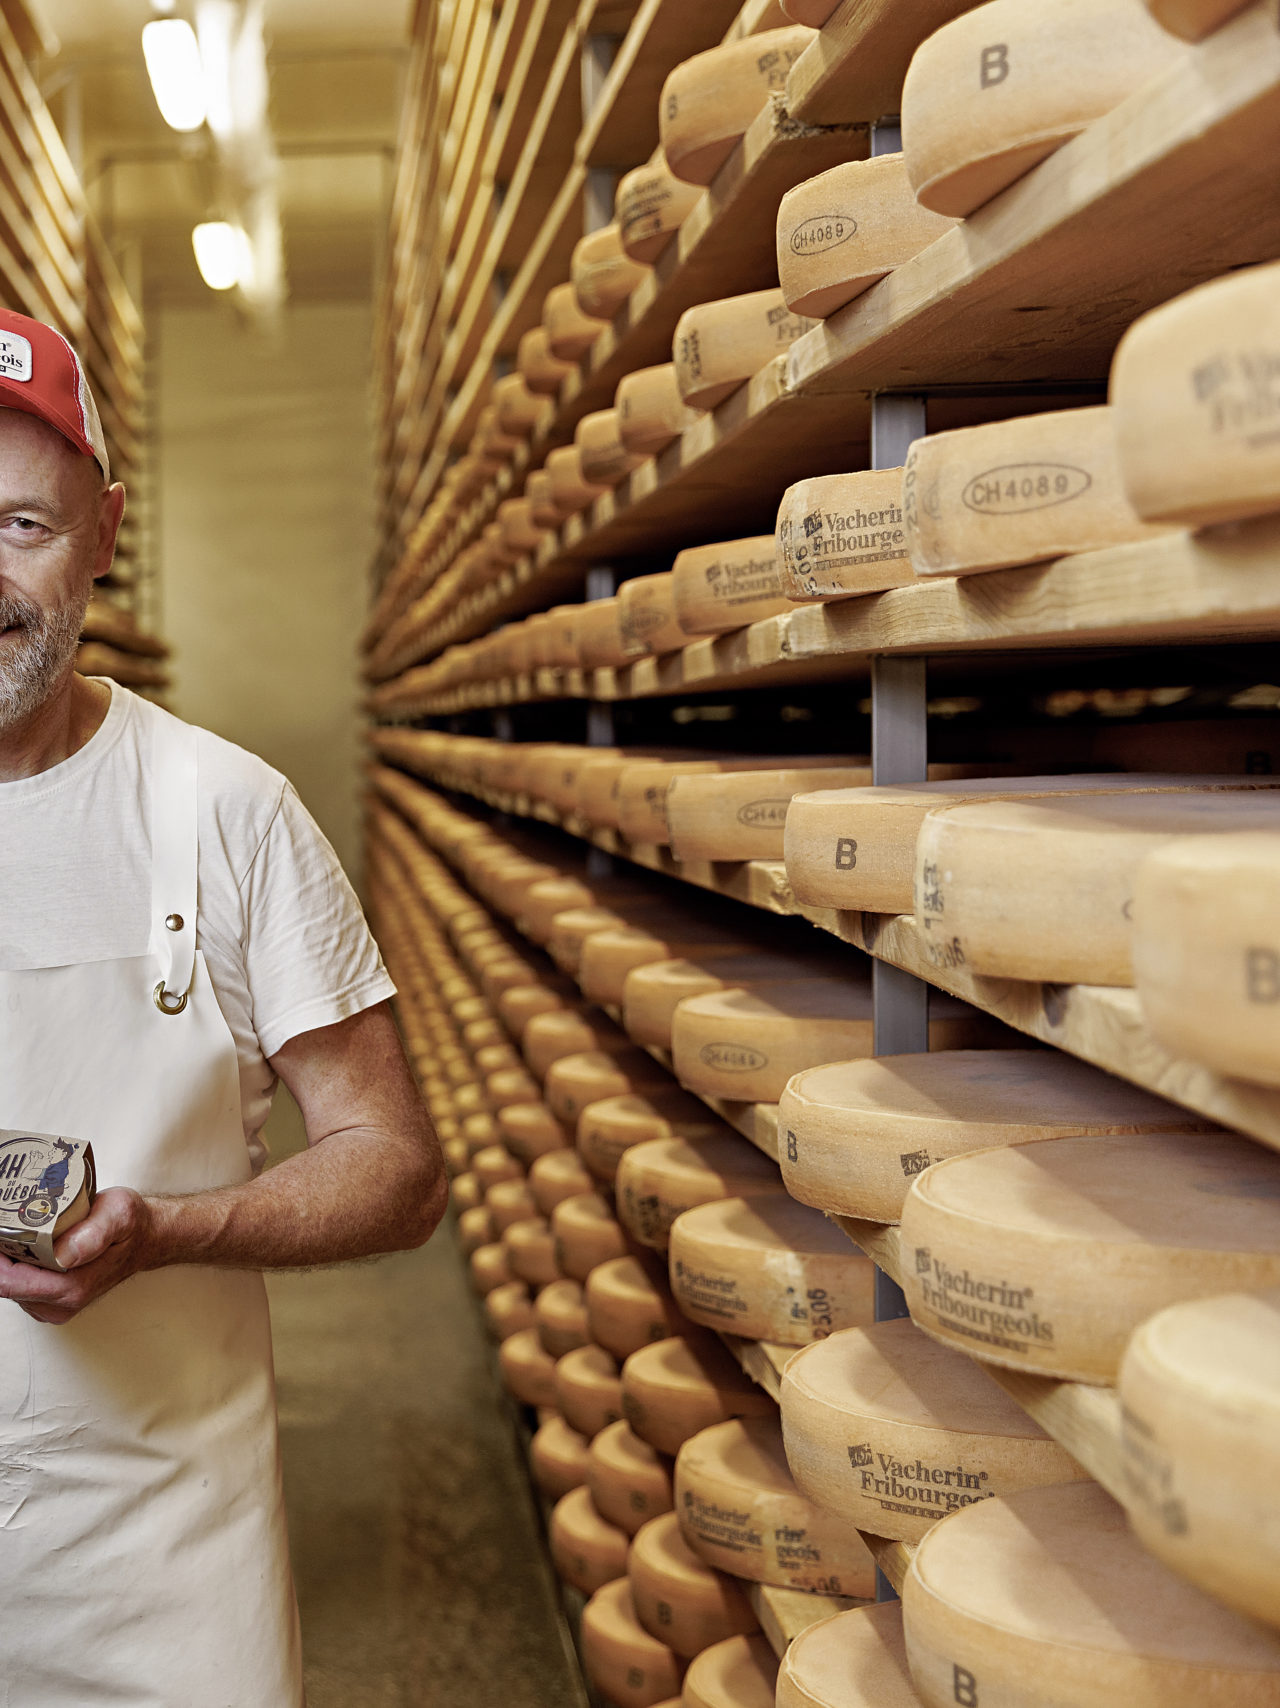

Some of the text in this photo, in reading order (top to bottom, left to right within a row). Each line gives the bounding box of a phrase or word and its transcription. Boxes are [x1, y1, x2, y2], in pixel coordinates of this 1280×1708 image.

[980, 44, 1010, 89] B
[794, 222, 844, 249] CH4089
[971, 473, 1069, 506] CH4089
[835, 837, 858, 871] B
[1245, 947, 1280, 1004] B
[786, 1129, 799, 1163] B
[920, 1275, 1055, 1342] Fribourgeois
[860, 1470, 995, 1512] Fribourge
[953, 1663, 979, 1708] B
